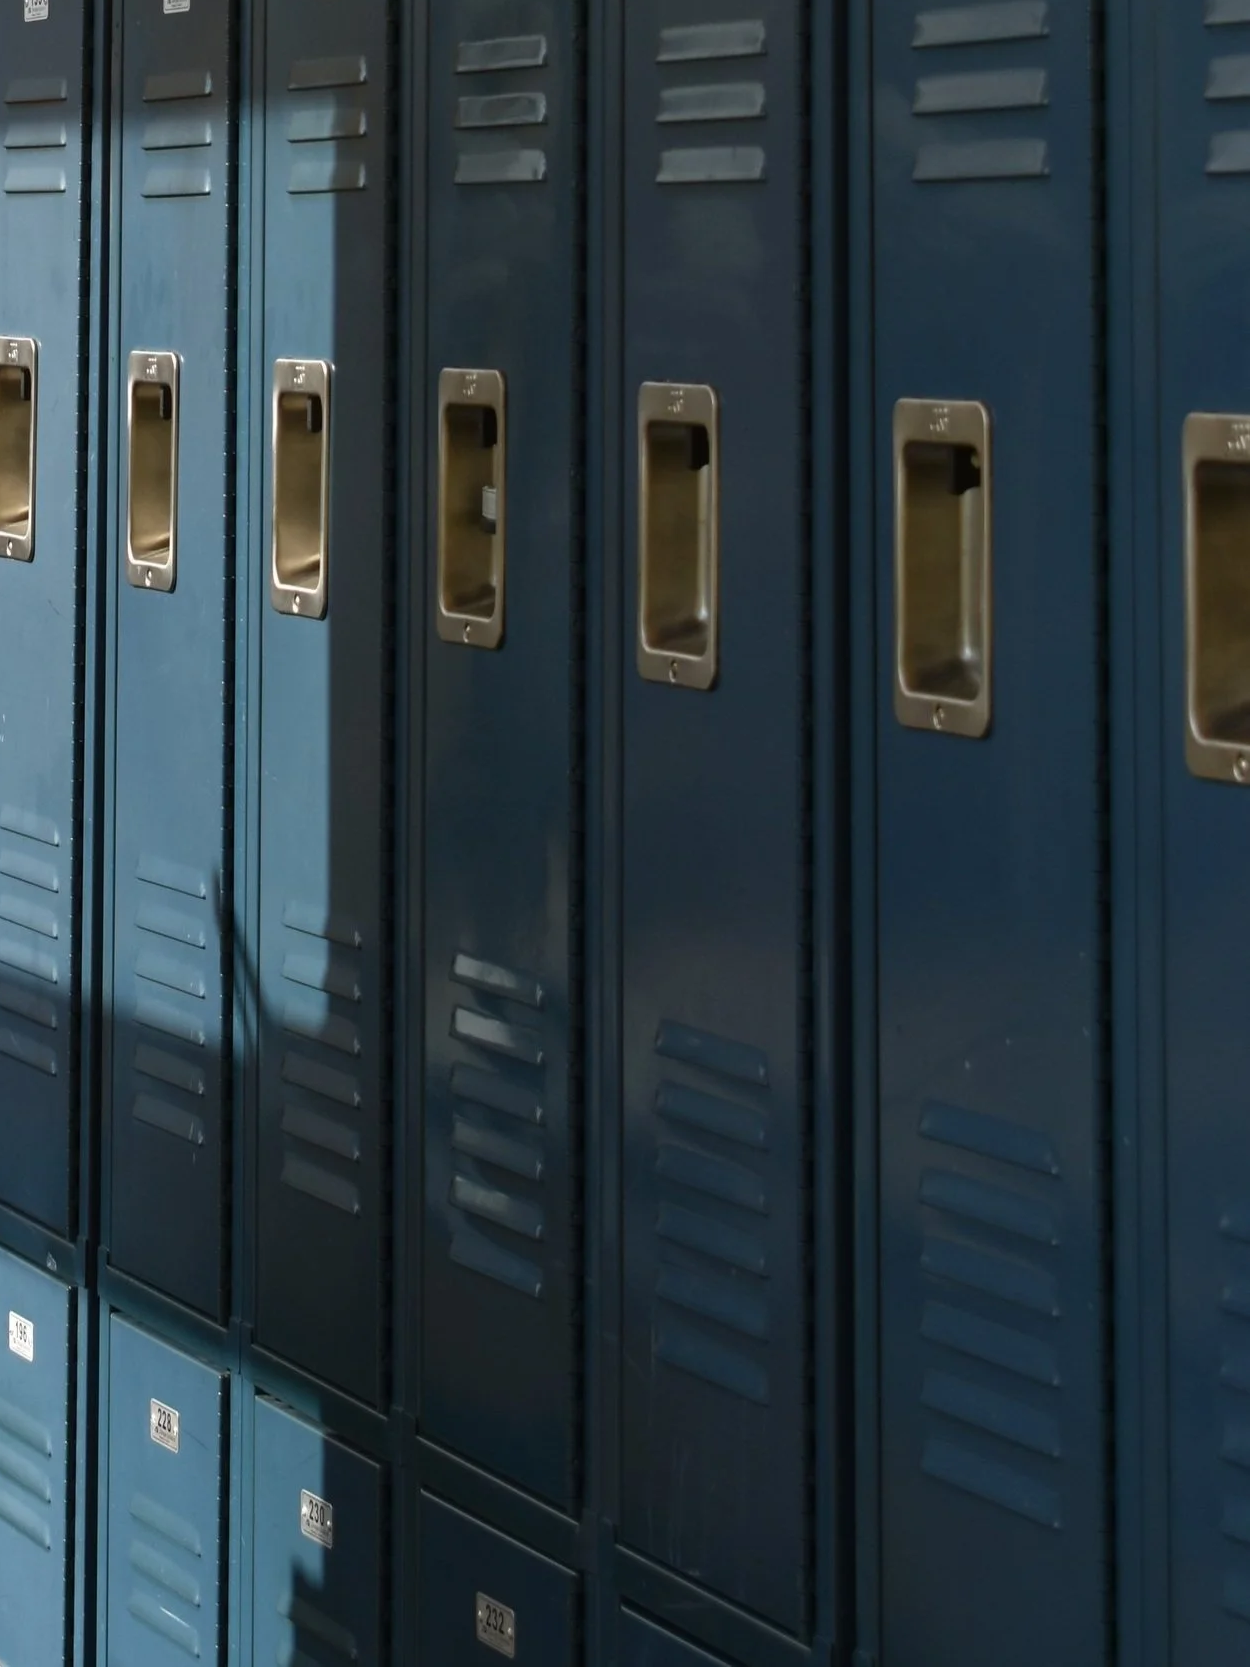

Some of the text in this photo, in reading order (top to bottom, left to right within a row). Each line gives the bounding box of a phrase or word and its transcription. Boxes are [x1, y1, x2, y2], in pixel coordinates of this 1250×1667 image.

[15, 1321, 27, 1342] 196
[157, 1408, 172, 1433] 228
[308, 1499, 325, 1526] 230
[485, 1604, 505, 1635] 232
